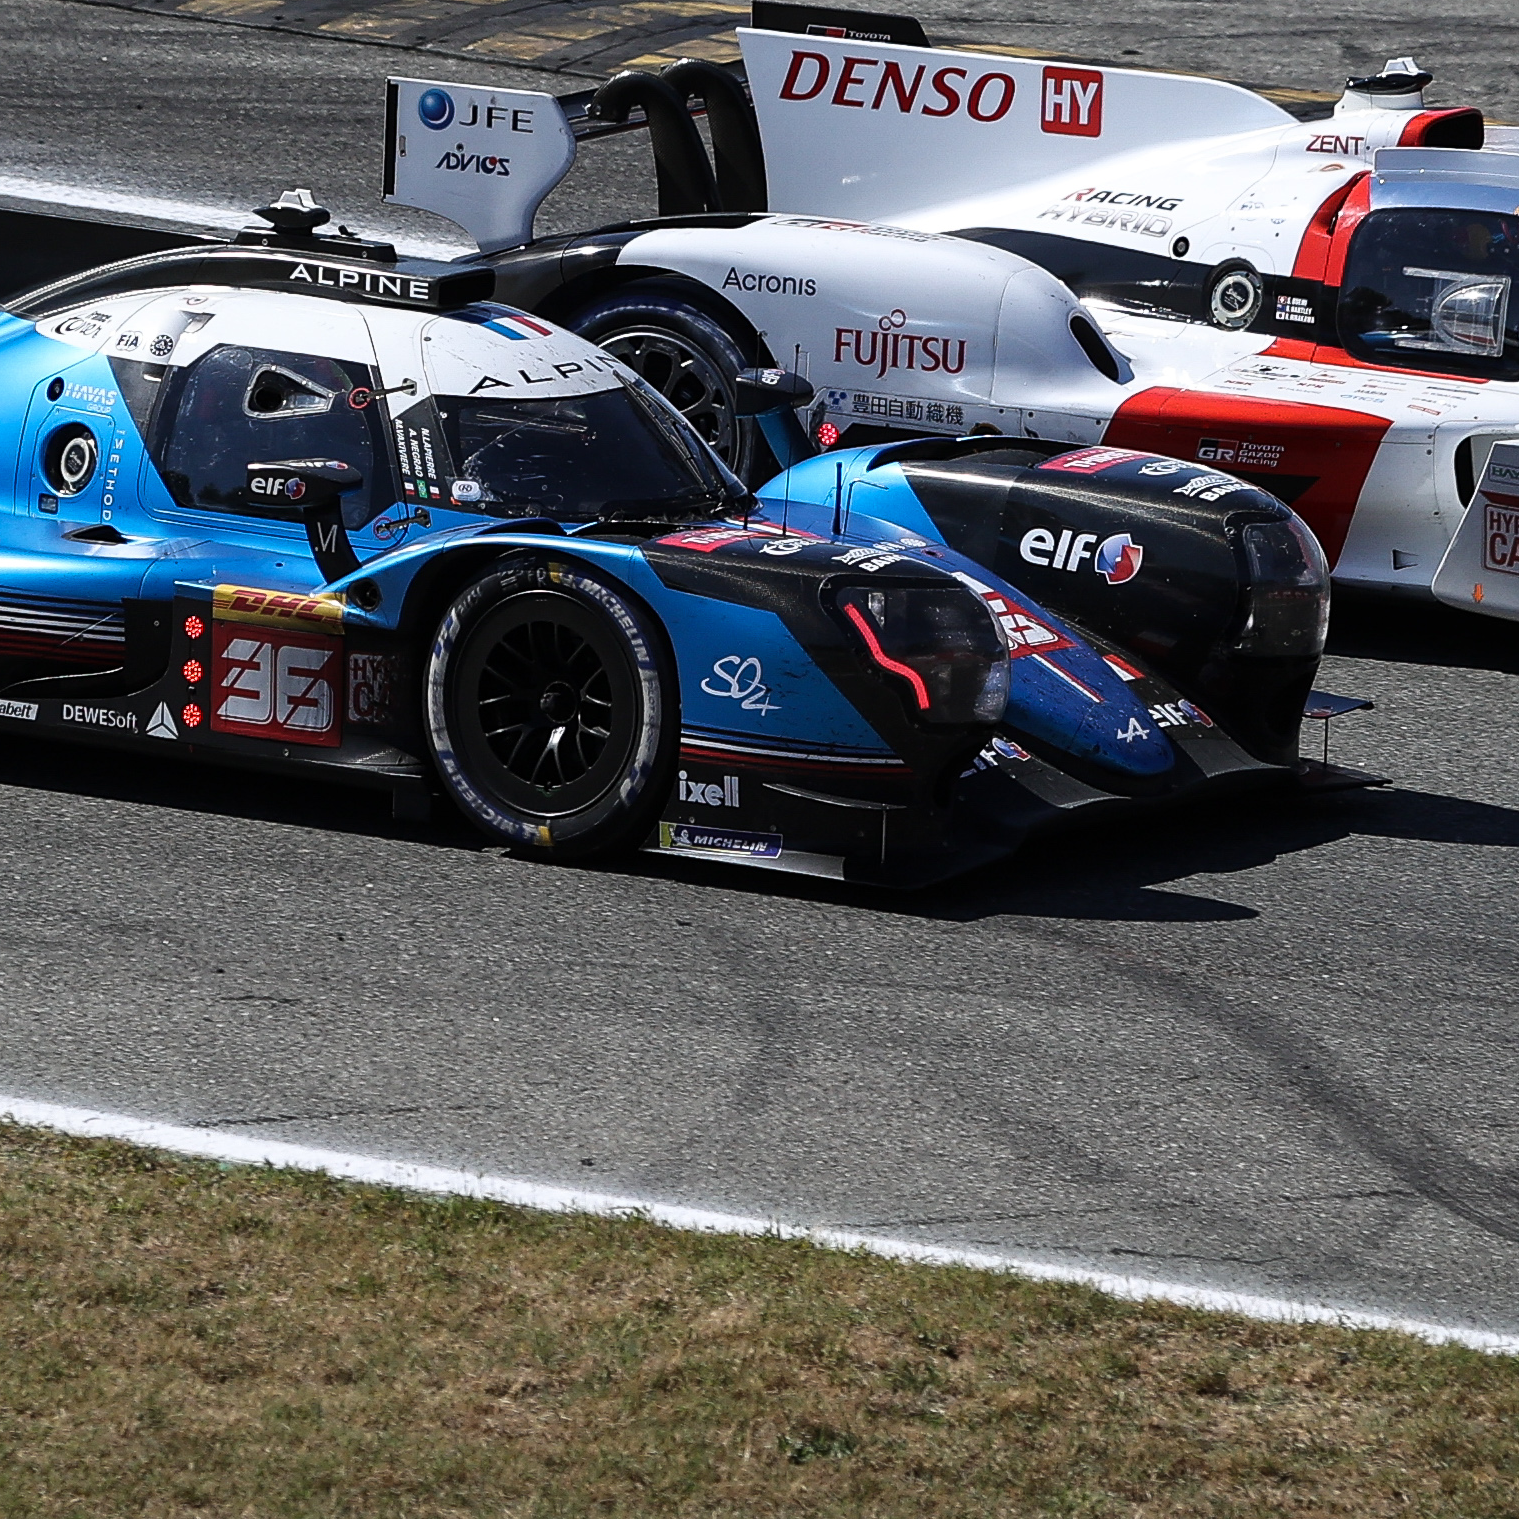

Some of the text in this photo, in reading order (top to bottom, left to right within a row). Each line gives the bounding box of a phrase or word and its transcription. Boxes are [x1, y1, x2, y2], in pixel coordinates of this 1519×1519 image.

[848, 30, 891, 41] TOYOTA
[779, 50, 1016, 122] DENSO
[1043, 77, 1099, 126] HY
[459, 104, 534, 133] JFE
[1306, 134, 1364, 155] ZENT
[435, 151, 510, 177] ADVICS
[1062, 187, 1184, 211] RACING
[1037, 204, 1173, 238] HYBRID
[290, 264, 429, 300] ALPINE
[722, 267, 817, 297] Acronis
[117, 334, 139, 348] FIA
[833, 323, 967, 380] FUJITSU
[64, 382, 118, 406] HAVAS
[1198, 442, 1285, 461] GR TOYOTA
[1237, 457, 1278, 468] Racing
[1239, 449, 1280, 459] GAZOO
[250, 477, 285, 496] elf
[1019, 527, 1099, 573] elf
[229, 590, 325, 622] DHL
[582, 578, 649, 663] MICHELIN
[217, 638, 334, 732] 36
[62, 703, 138, 730] DEWESoft
[443, 758, 518, 835] MICHELIN
[678, 770, 740, 808] ixell
[693, 834, 768, 853] MICHELIN
